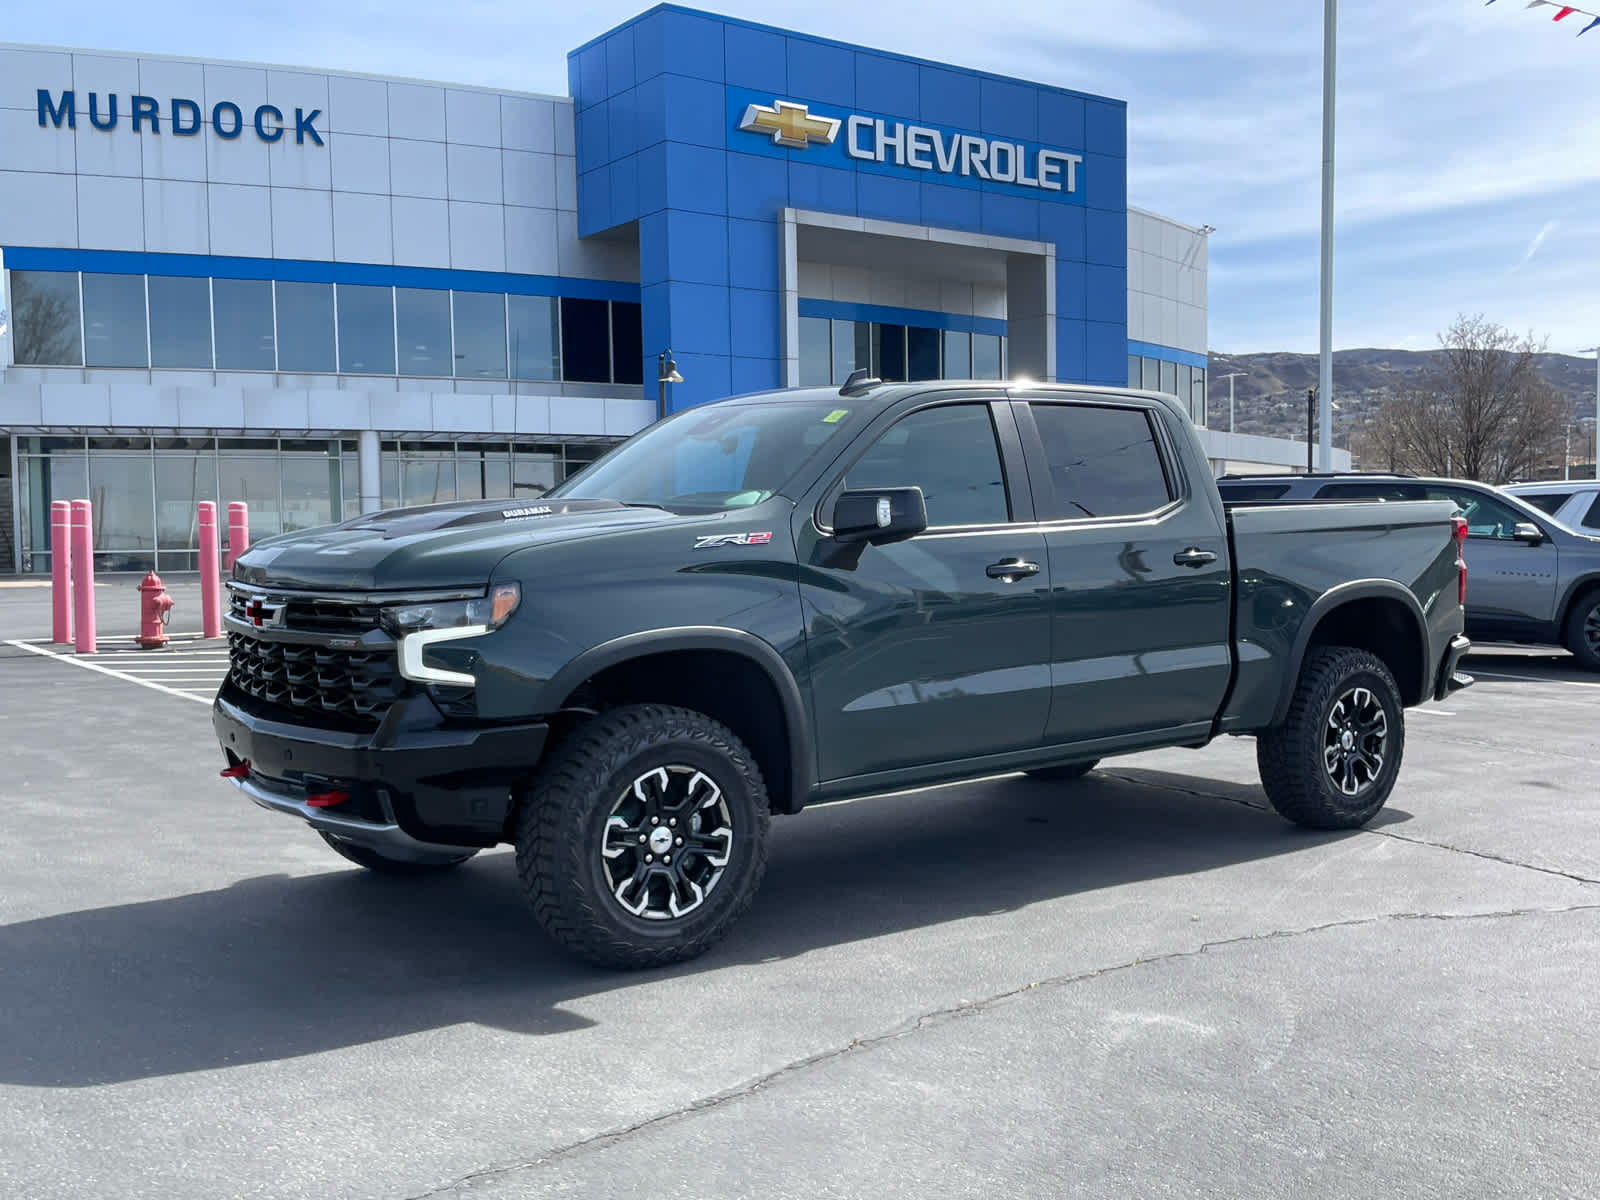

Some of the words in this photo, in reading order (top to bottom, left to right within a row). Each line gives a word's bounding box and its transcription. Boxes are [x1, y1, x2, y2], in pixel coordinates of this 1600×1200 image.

[37, 88, 325, 147] MURDOCK
[848, 114, 1083, 193] CHEVROLET
[502, 505, 553, 519] DURAMAX
[693, 531, 773, 549] ZR2
